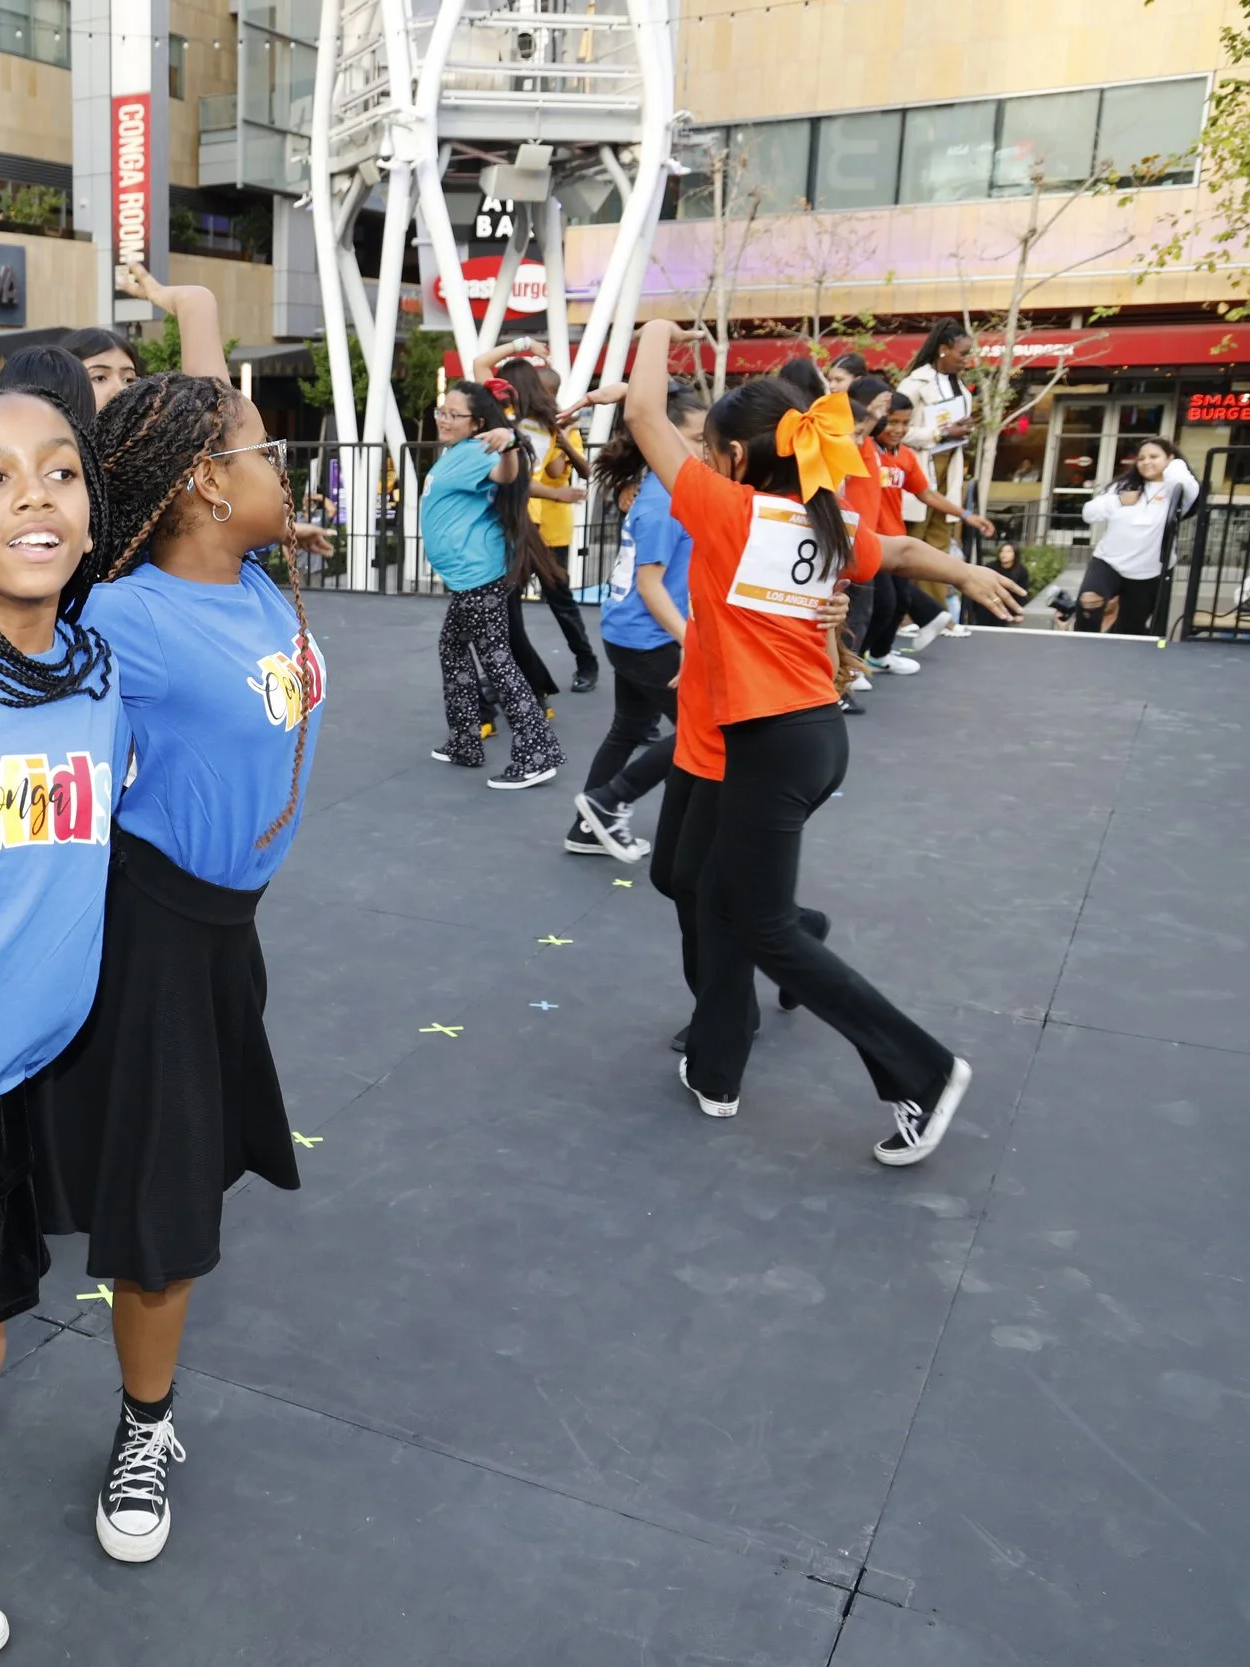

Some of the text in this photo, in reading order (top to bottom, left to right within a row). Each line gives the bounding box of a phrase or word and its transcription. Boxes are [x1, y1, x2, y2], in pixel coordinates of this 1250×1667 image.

[118, 103, 145, 188] CONGA
[118, 191, 145, 263] ROOM
[791, 538, 818, 585] 8
[766, 590, 819, 608] LOS ANGELES
